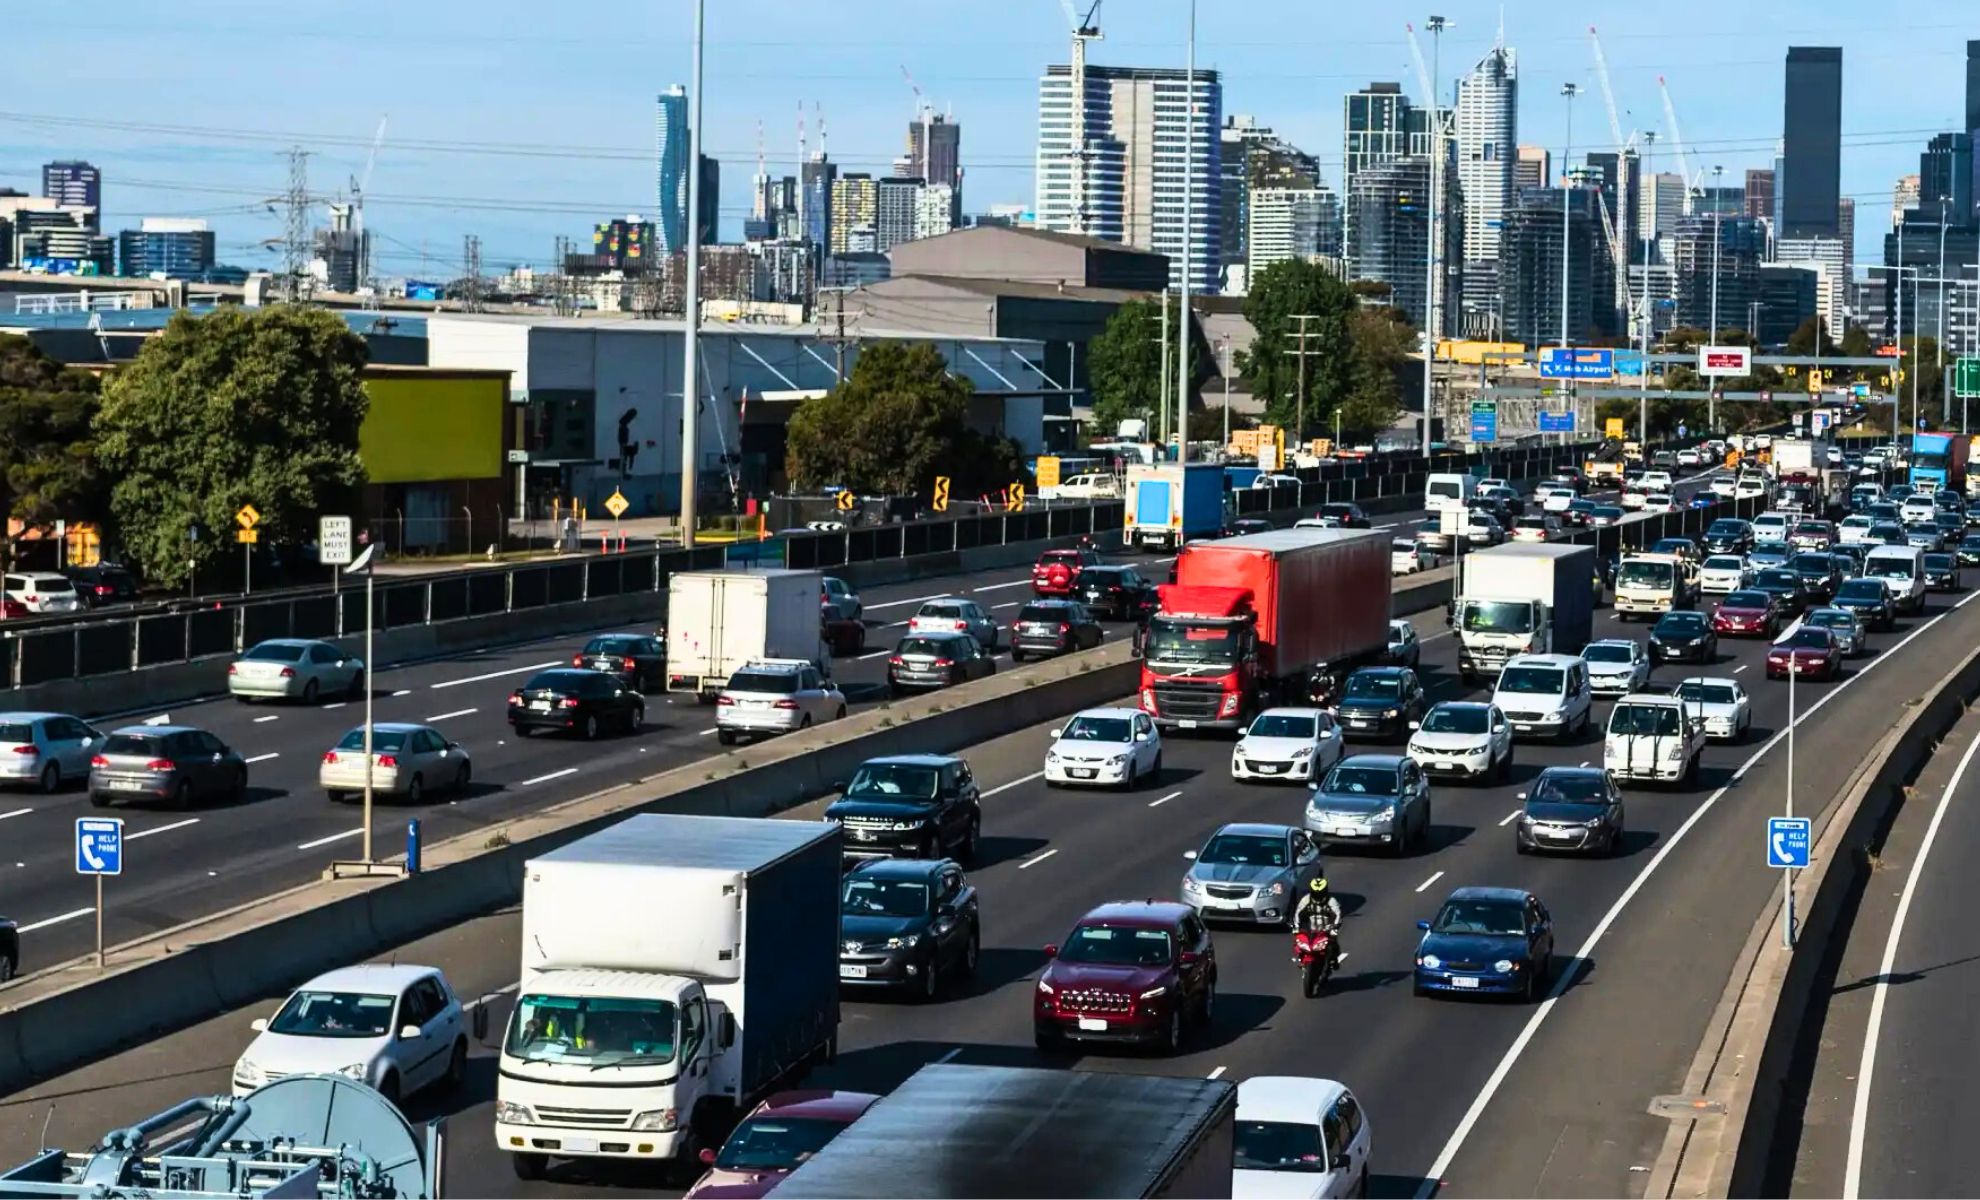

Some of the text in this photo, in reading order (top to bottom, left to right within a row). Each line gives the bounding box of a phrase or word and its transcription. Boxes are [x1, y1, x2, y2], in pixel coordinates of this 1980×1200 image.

[1583, 365, 1611, 374] Airport
[326, 551, 345, 559] EXIT
[98, 834, 117, 843] HELP
[1789, 832, 1806, 840] HELP
[98, 844, 117, 853] PHONE
[1788, 841, 1806, 849] PHONE
